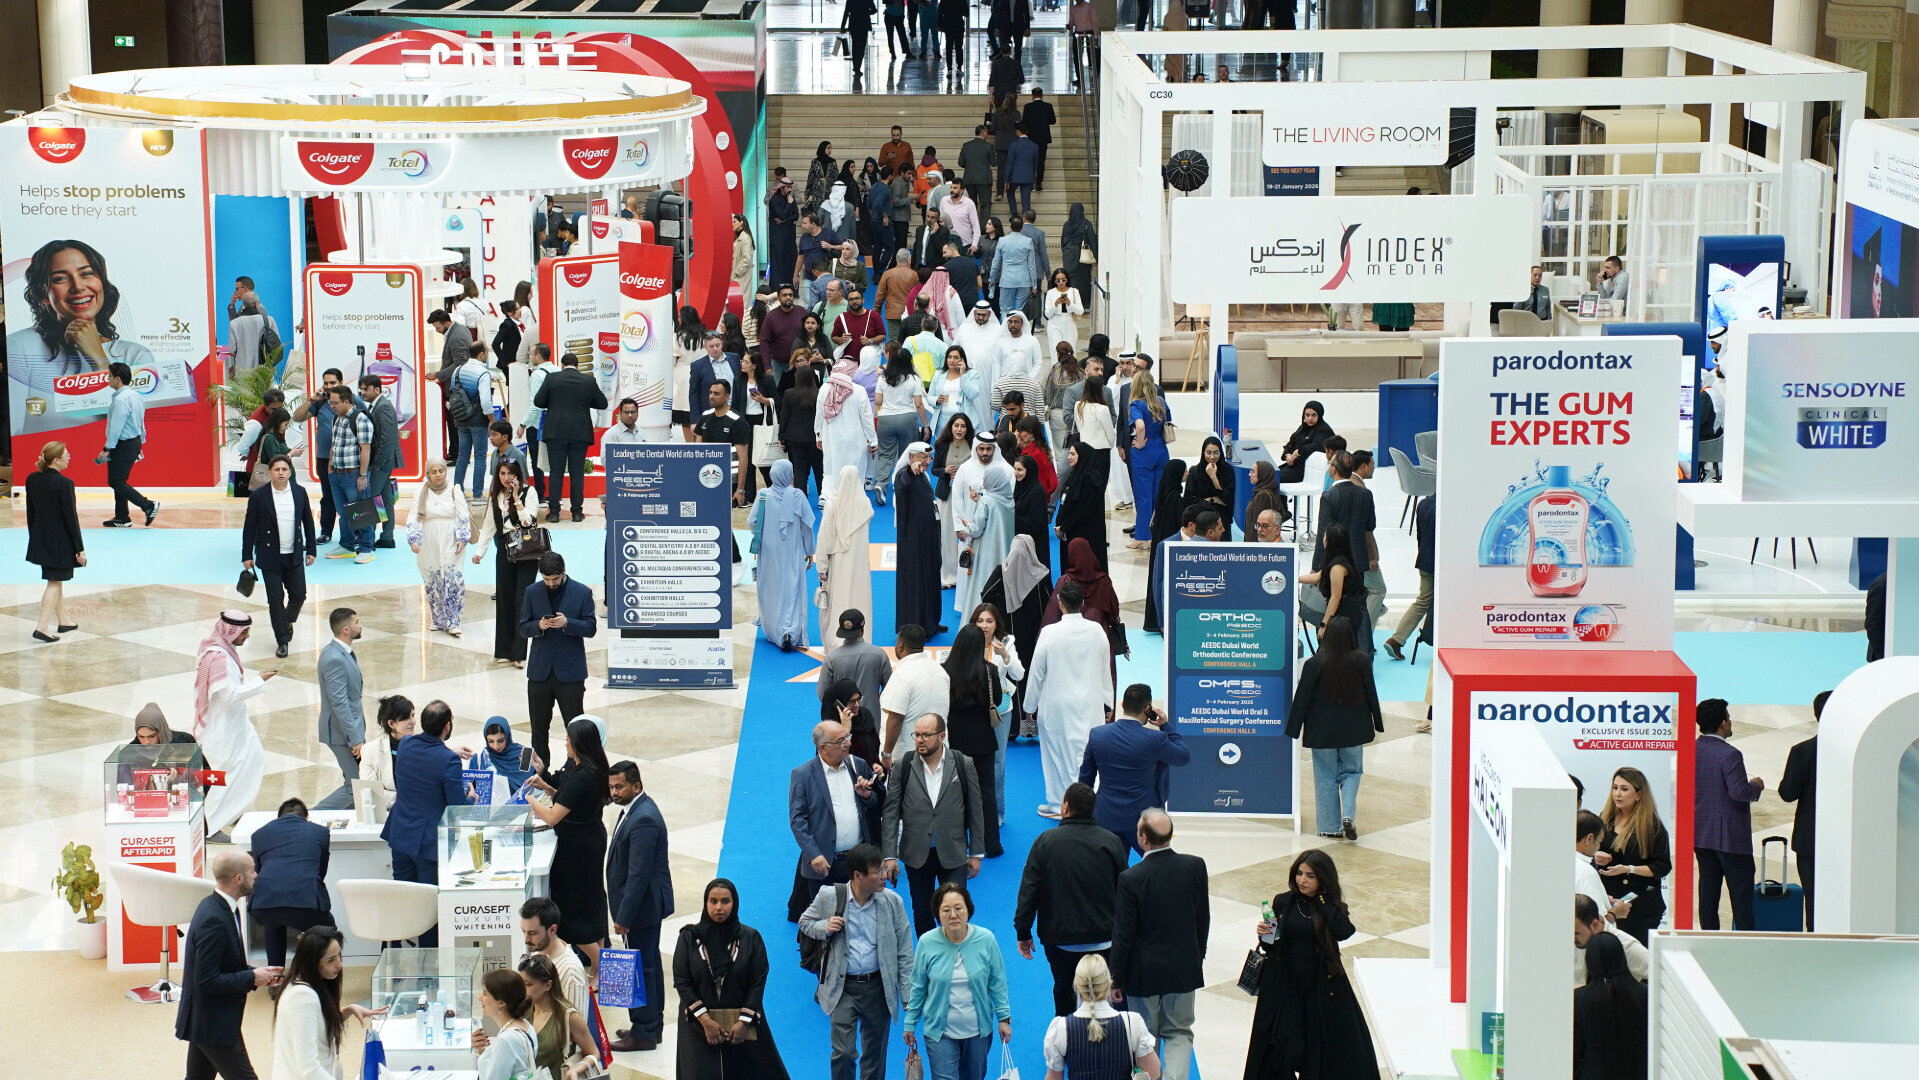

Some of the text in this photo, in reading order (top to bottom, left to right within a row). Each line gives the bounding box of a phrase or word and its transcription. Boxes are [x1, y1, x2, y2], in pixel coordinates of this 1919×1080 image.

[1150, 90, 1173, 98] CC30
[1273, 126, 1441, 143] THE LIVING ROOM
[39, 141, 77, 150] Colgate
[309, 152, 361, 164] Colgate
[572, 148, 610, 160] Colgate
[626, 148, 644, 158] Total
[388, 158, 420, 168] Total
[20, 184, 186, 201] Helps stop problems
[21, 202, 138, 220] before they start
[1367, 264, 1443, 276] MEDIA
[620, 272, 666, 288] Colgate
[571, 306, 596, 314] advanced
[322, 313, 404, 322] Helps stop problems
[564, 310, 570, 322] 1
[572, 314, 598, 322] protective
[168, 318, 190, 334] 3x
[348, 322, 362, 332] they
[621, 324, 646, 336] Total
[1492, 350, 1632, 377] parodontax
[1782, 382, 1906, 398] SENSODYNE
[1490, 392, 1633, 416] THE GUM
[1806, 410, 1879, 420] CLINICAL
[1490, 420, 1631, 446] EXPERTS
[1808, 424, 1874, 446] WHITE
[613, 450, 724, 459] Leading the Dental World into the Future
[1176, 553, 1286, 563] Leading the Dental World into the Future
[1199, 613, 1256, 621] ORTHO
[1487, 611, 1566, 626] parodontax
[1199, 680, 1254, 688] OMFS
[1478, 697, 1671, 723] parodontax
[1219, 717, 1244, 725] Surgery
[1590, 740, 1674, 750] ACTIVE GUM REPAIR
[121, 837, 175, 846] CURASEPT
[454, 905, 510, 915] CURASEPT
